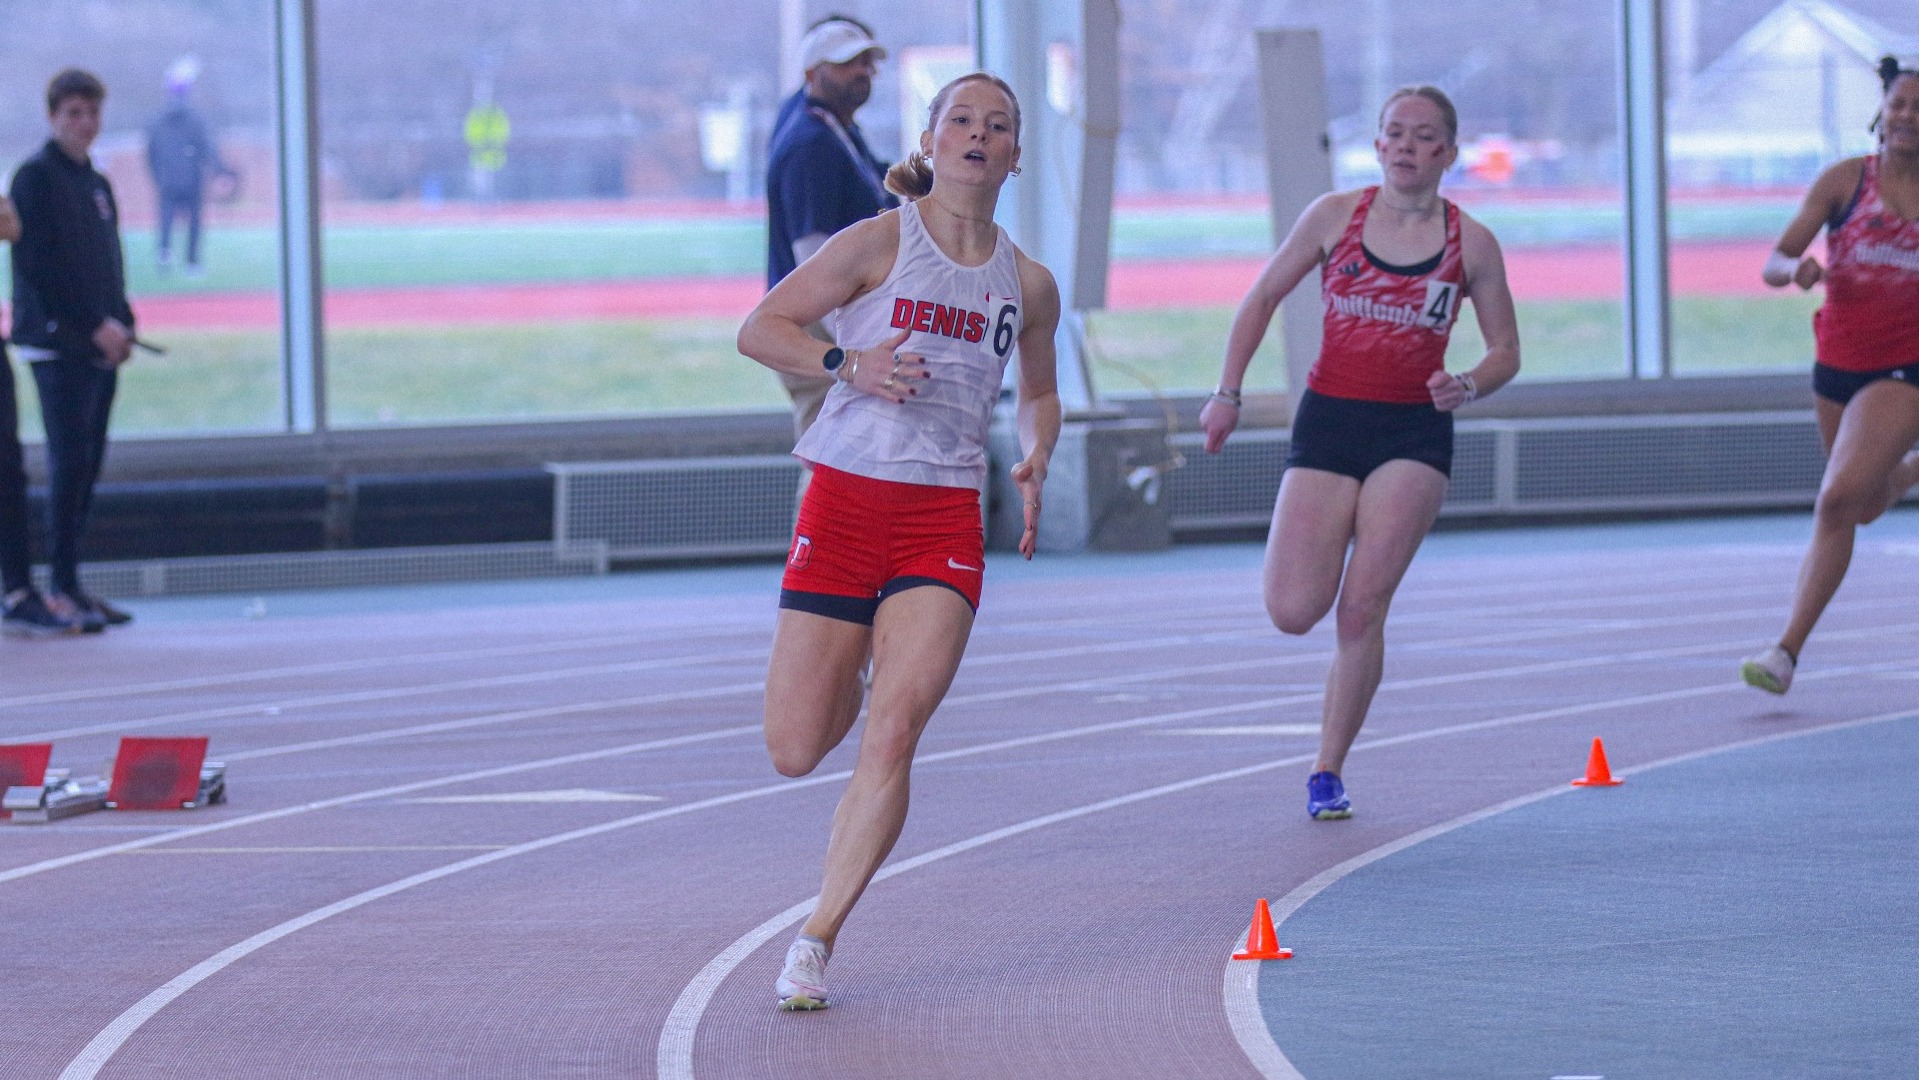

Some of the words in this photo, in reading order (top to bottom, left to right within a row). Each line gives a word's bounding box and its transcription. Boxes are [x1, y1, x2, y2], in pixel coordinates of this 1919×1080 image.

[890, 298, 990, 343] DENIS
[1427, 286, 1452, 325] 4
[993, 304, 1018, 358] 6
[789, 534, 814, 570] D
